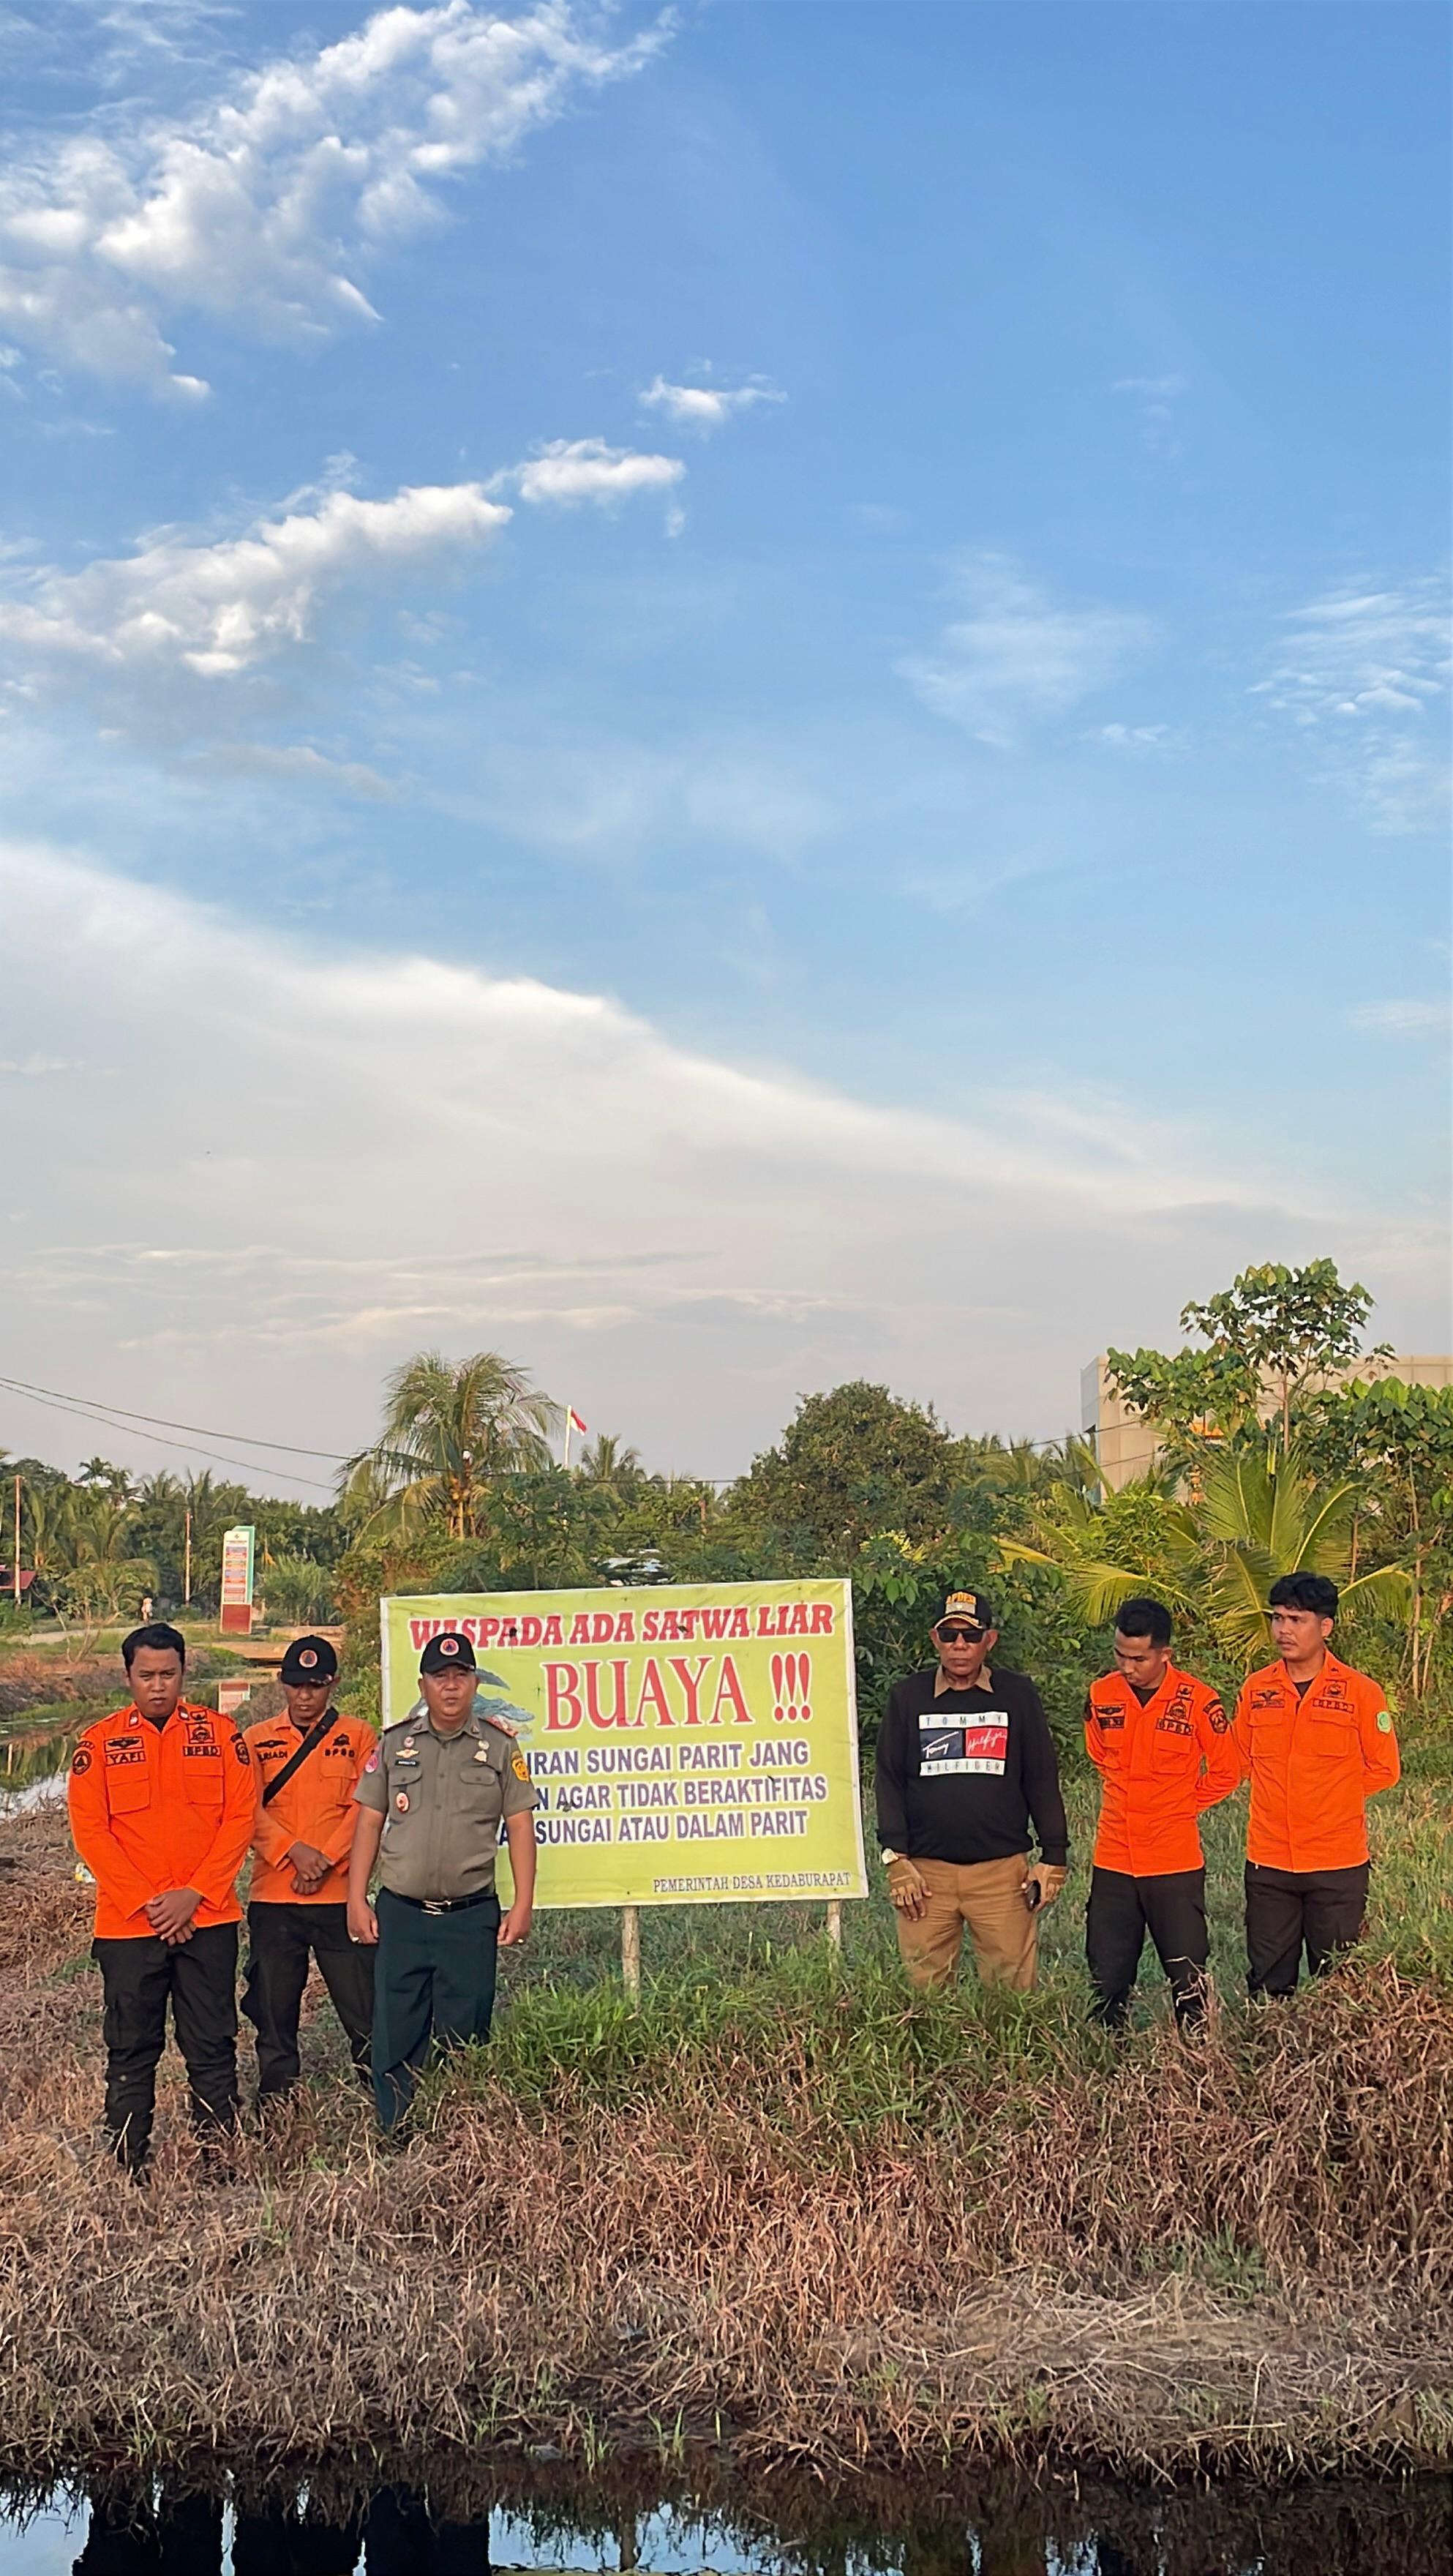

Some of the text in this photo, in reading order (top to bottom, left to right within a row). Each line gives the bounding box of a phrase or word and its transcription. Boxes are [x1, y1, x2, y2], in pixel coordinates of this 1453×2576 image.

[569, 1612, 635, 1644] ADA
[642, 1607, 750, 1641] SATWA
[756, 1604, 833, 1636] LIAR
[542, 1652, 811, 1731] BUAYA !!!
[926, 1715, 1002, 1726] TOMMY
[526, 1741, 808, 1775] IRAN SUNGAI PARIT JANG
[926, 1761, 1000, 1772] HILFIGER
[556, 1784, 612, 1811] AGAR
[617, 1781, 678, 1808] TIDAK
[684, 1775, 827, 1805] BERAKTIFITAS
[536, 1818, 612, 1844] SUNGAI
[618, 1816, 669, 1841] ATAU
[676, 1813, 745, 1838] DALAM
[751, 1811, 808, 1835] PARIT
[653, 1872, 850, 1892] PEMERINTAH DESA KEDABURAPAT
